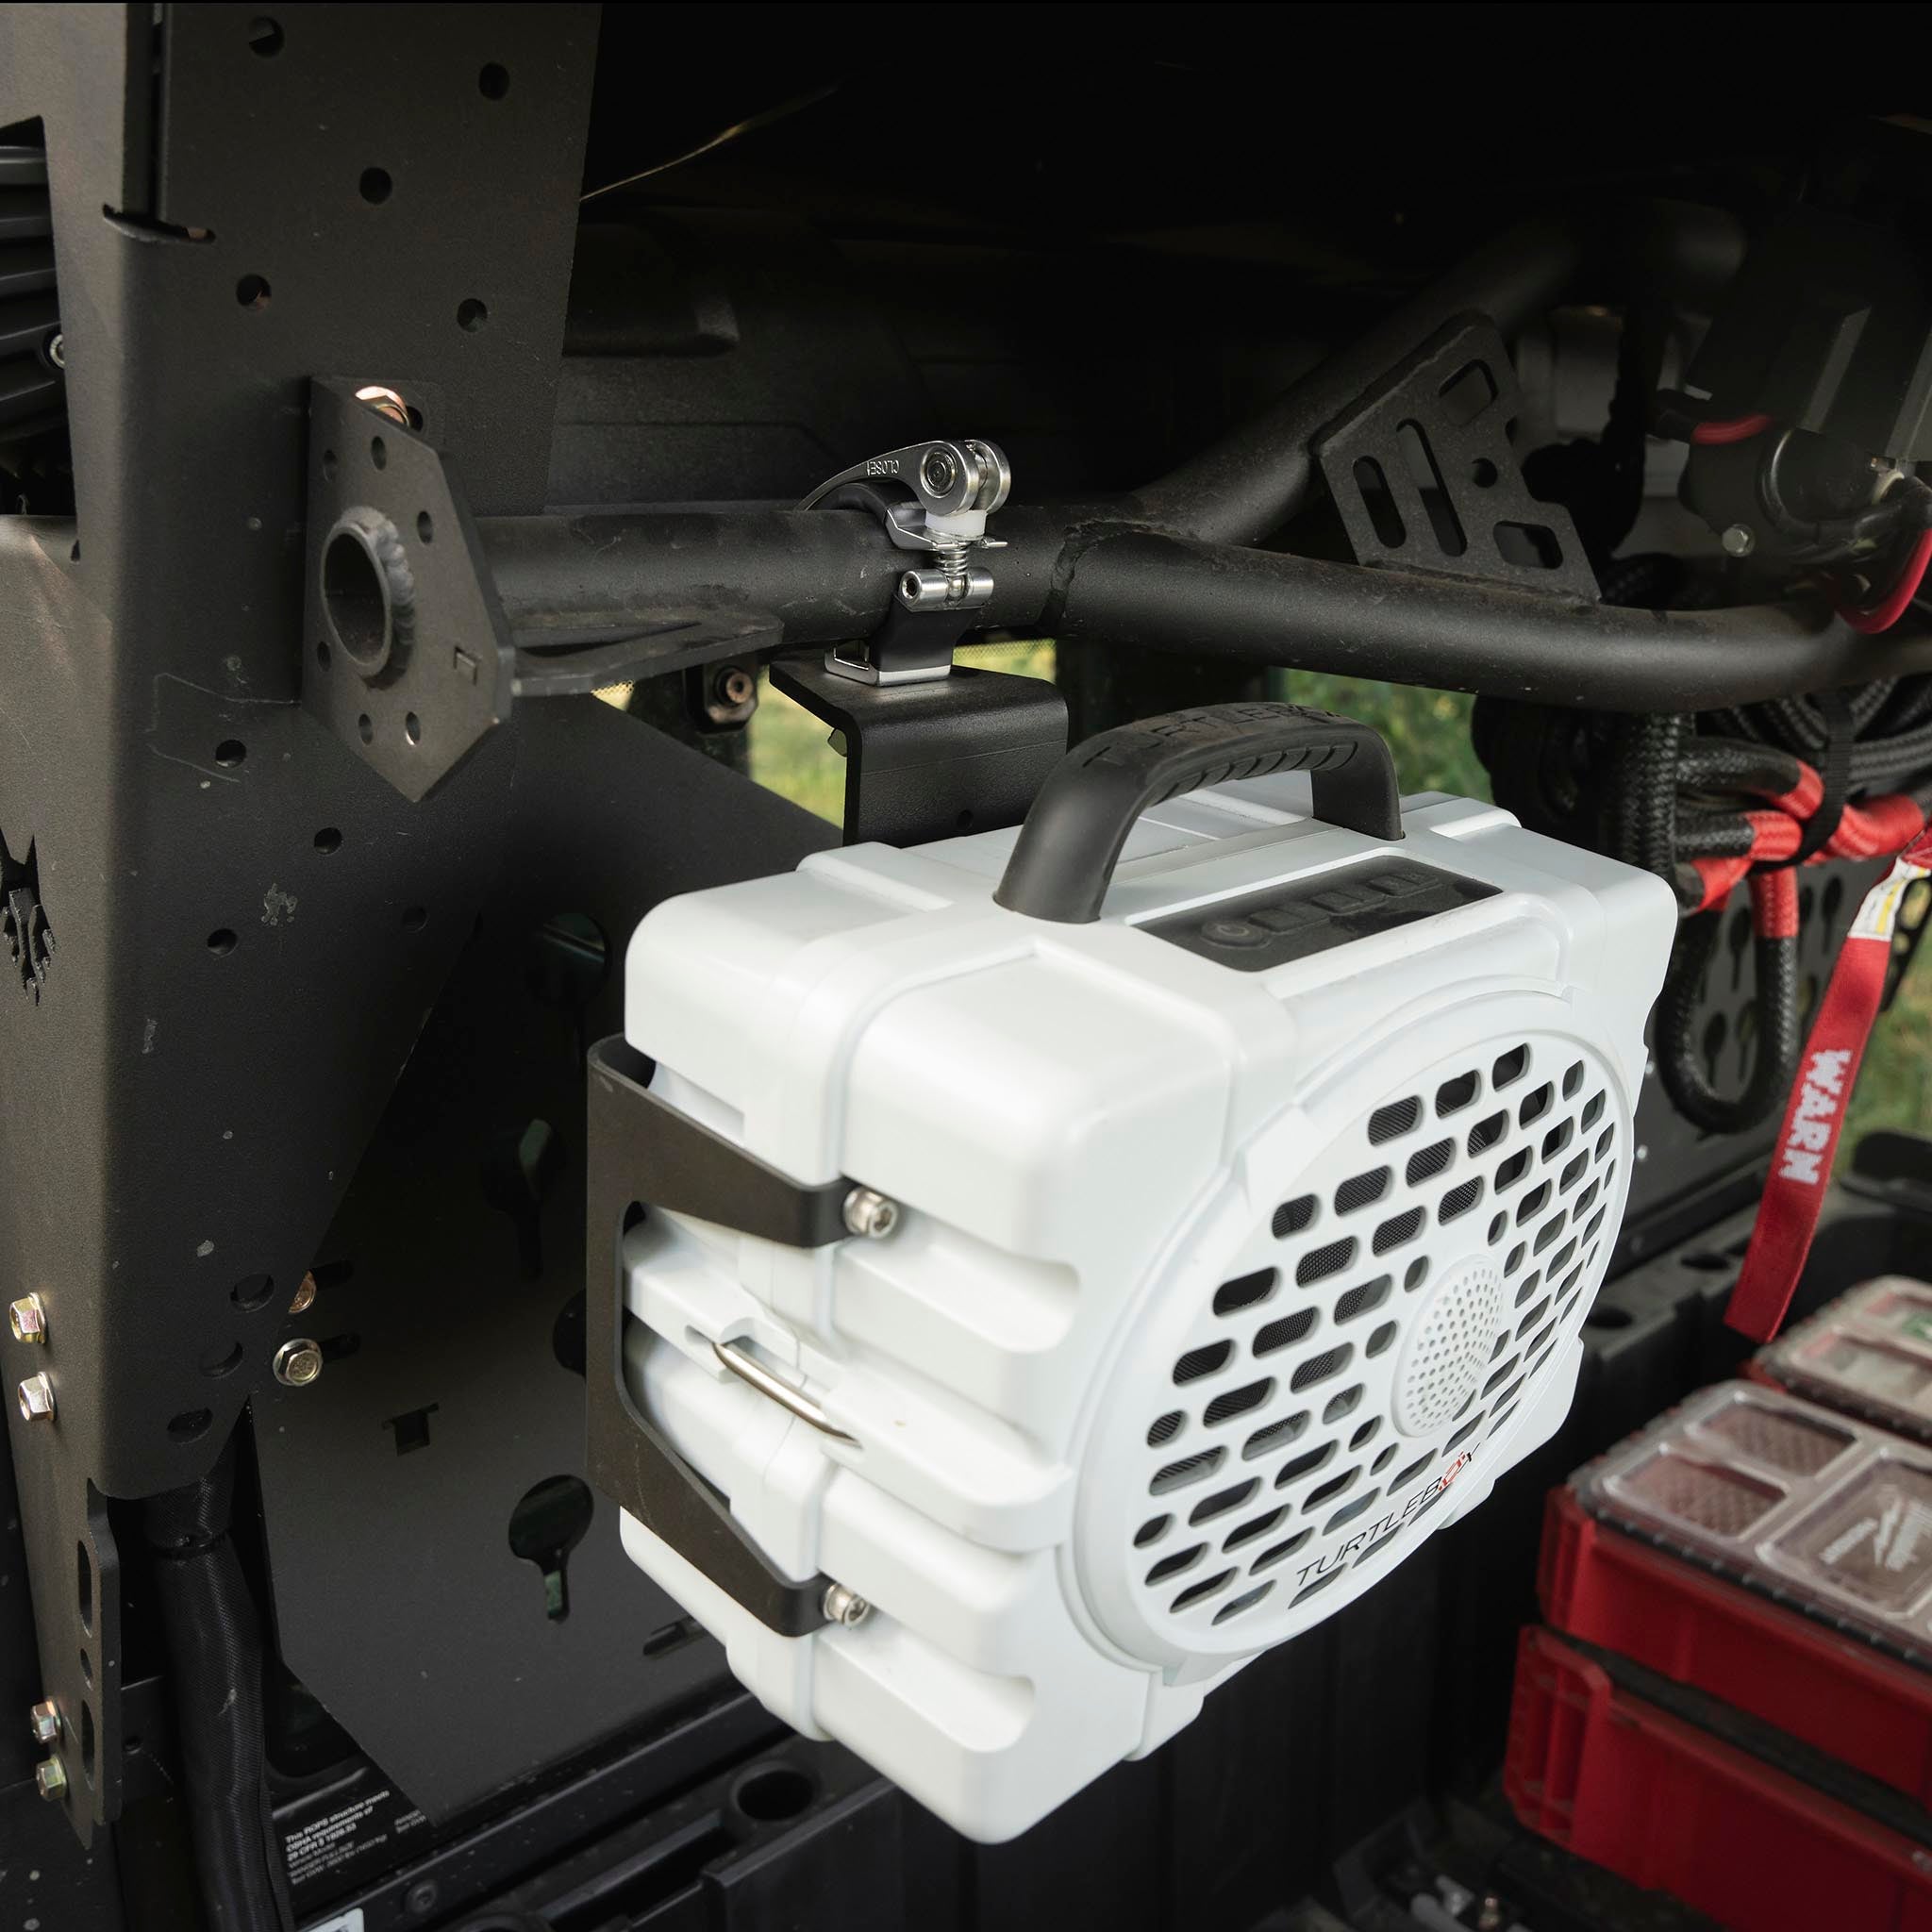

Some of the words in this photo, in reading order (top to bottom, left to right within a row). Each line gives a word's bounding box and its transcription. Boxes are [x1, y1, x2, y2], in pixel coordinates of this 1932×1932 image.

[870, 459, 900, 475] CLOSE
[1778, 1049, 1853, 1185] WARN
[303, 1818, 328, 1835] ROPS
[329, 1802, 365, 1823] structure
[364, 1790, 390, 1806] meets
